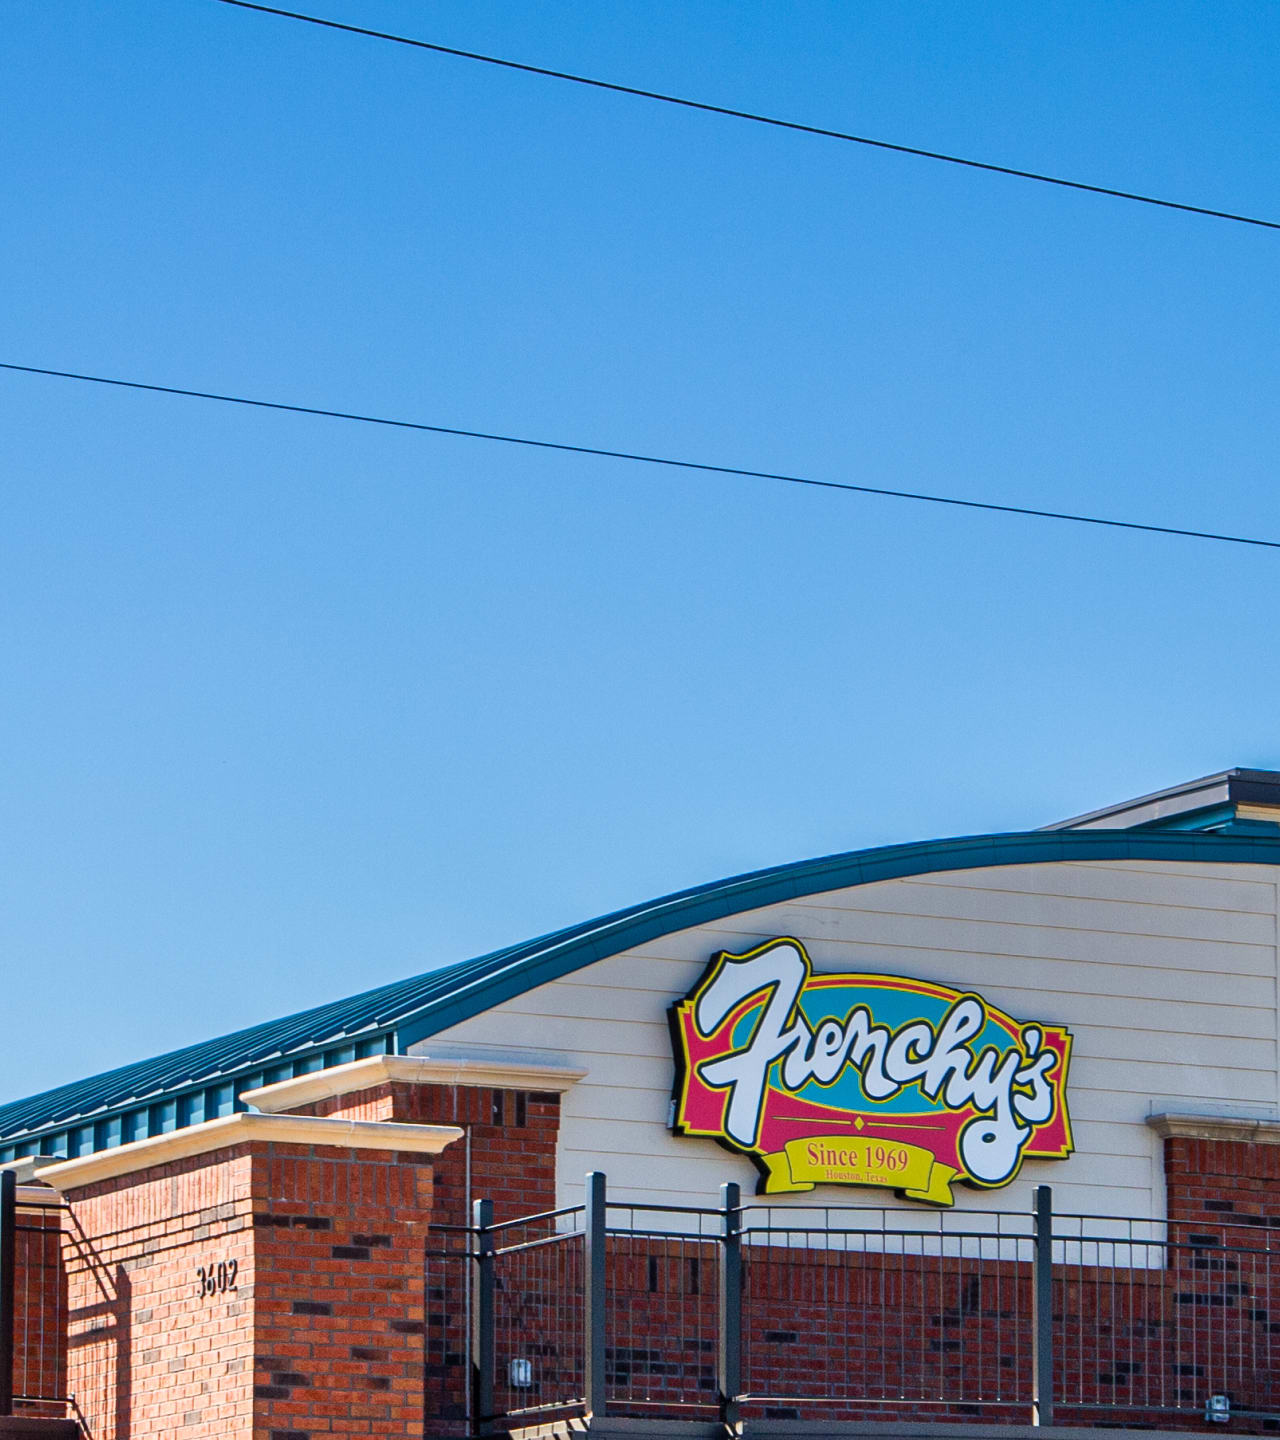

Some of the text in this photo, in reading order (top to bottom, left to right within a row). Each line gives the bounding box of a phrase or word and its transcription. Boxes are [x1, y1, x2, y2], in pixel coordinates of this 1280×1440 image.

[697, 943, 1055, 1182] Frenchy's
[807, 1142, 909, 1171] Since 1969
[826, 1169, 888, 1183] Houston, Texas
[196, 1259, 239, 1300] 3602
